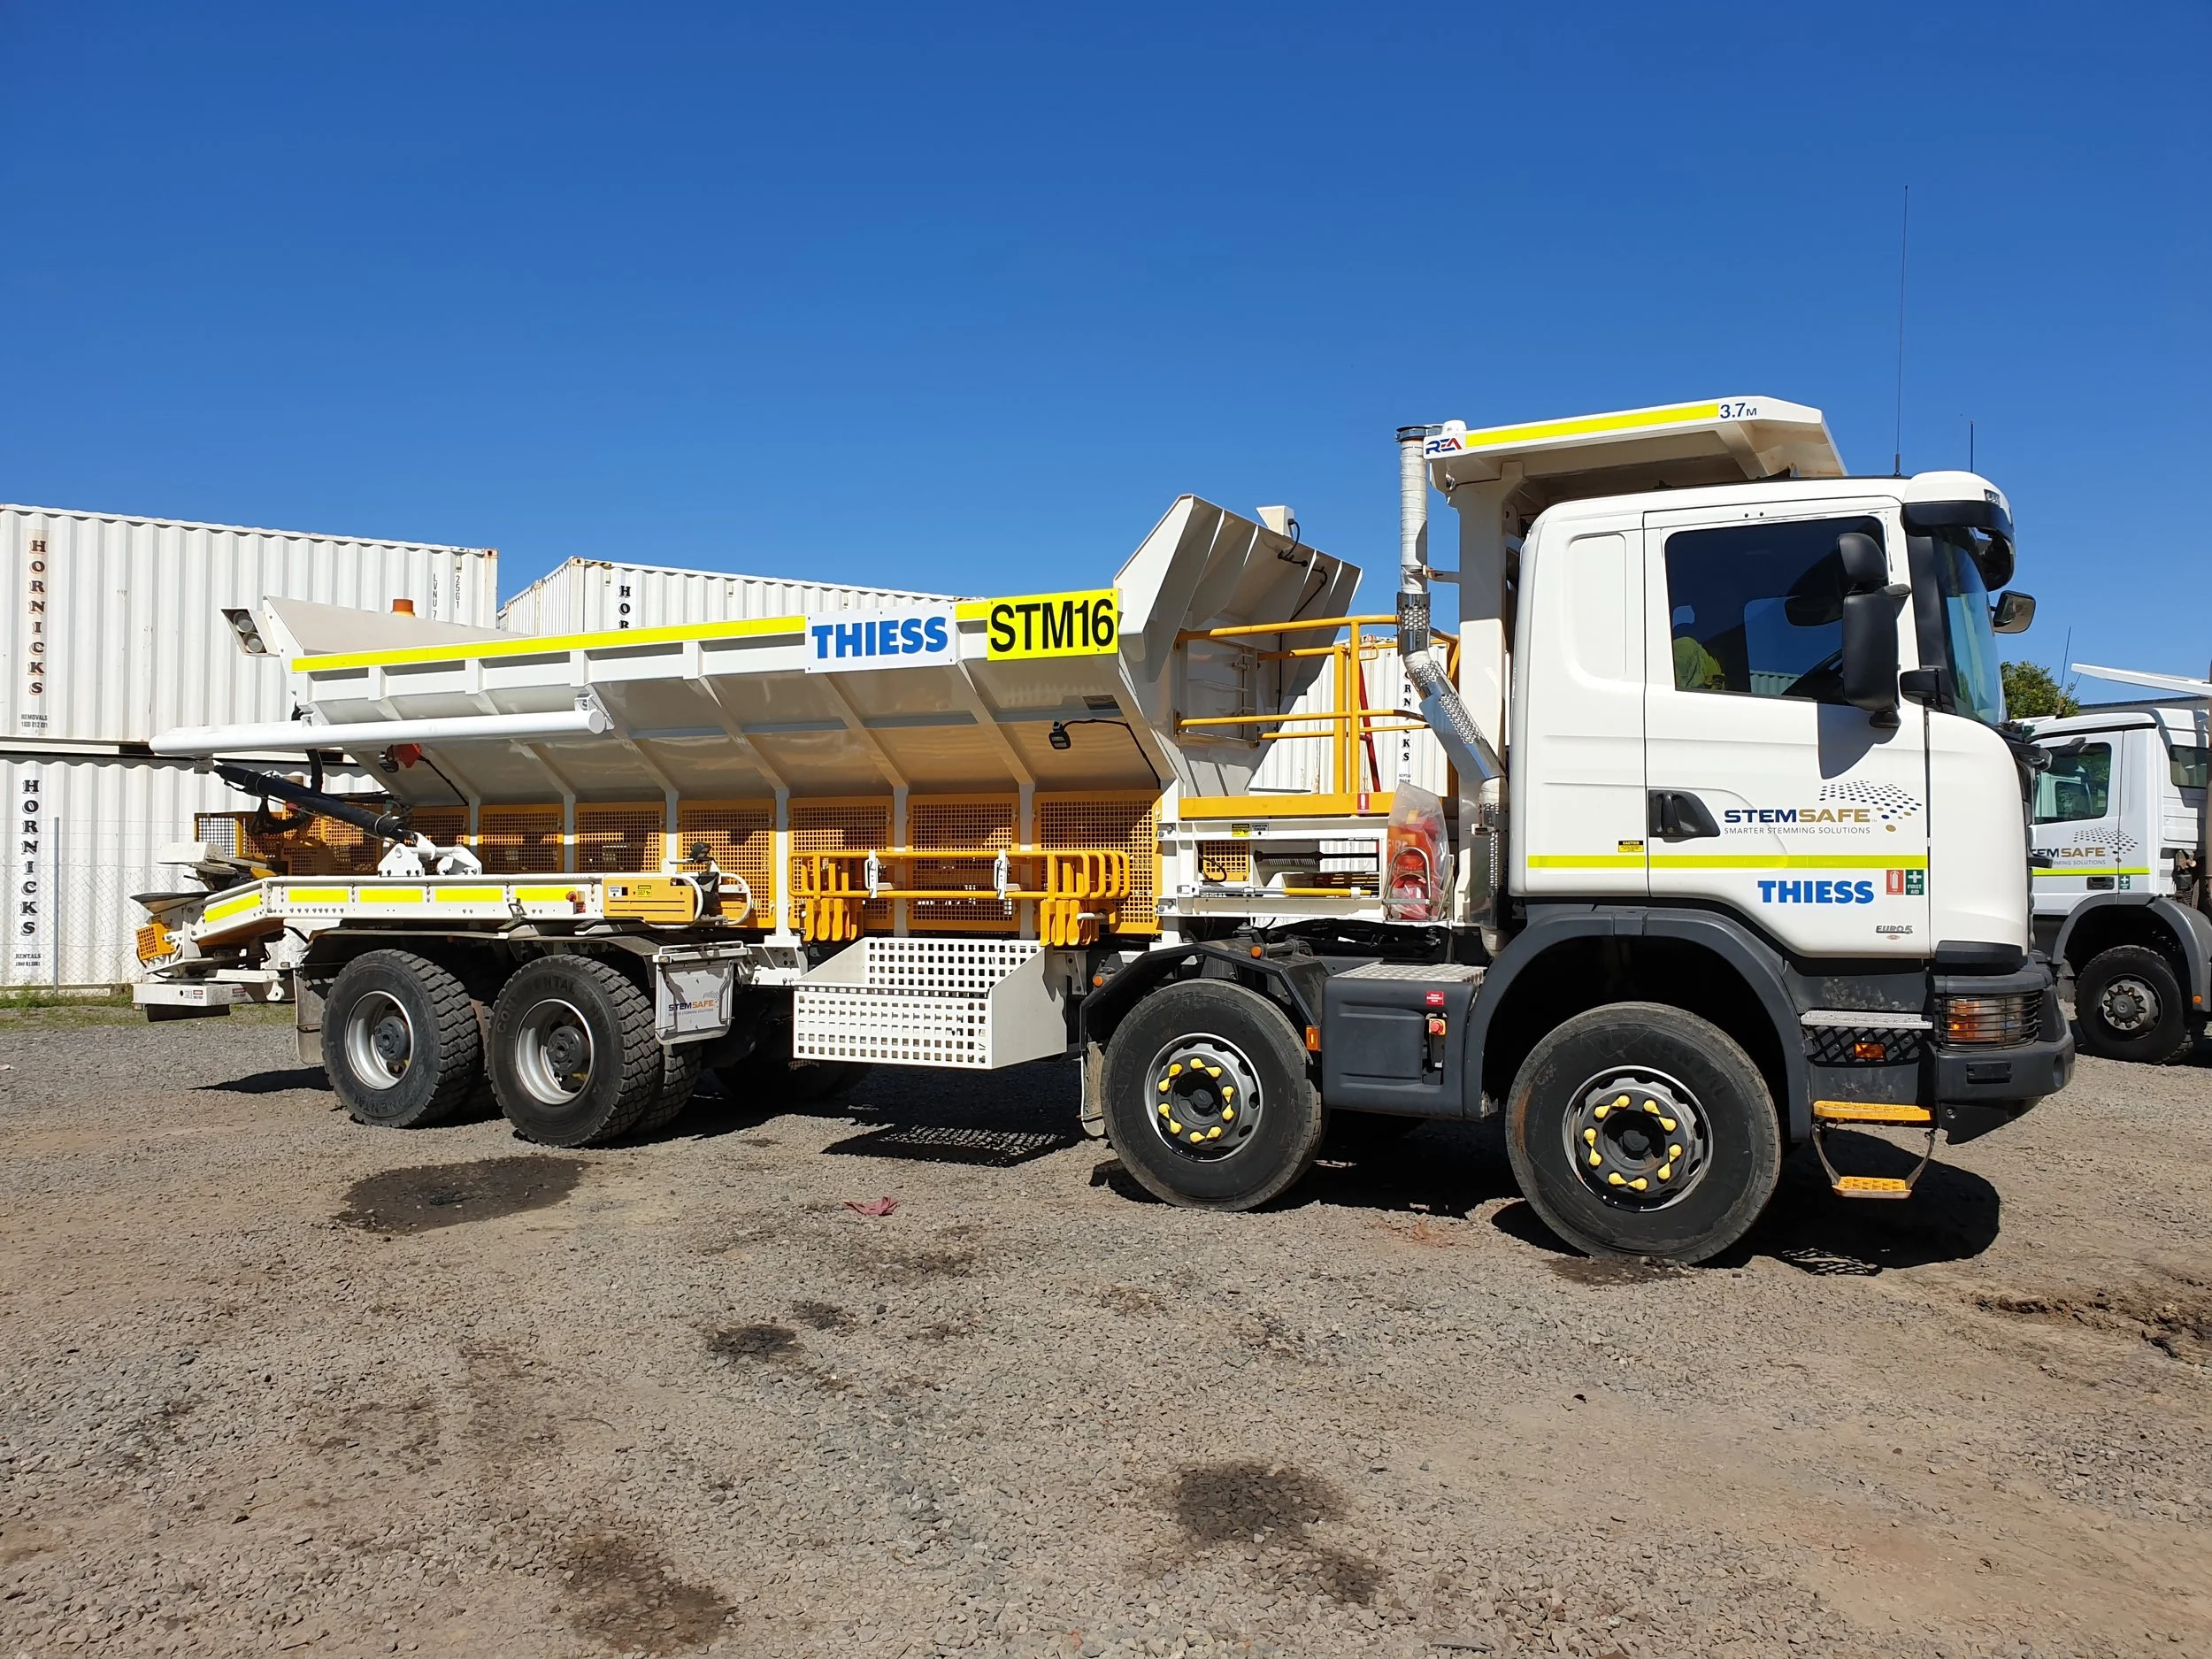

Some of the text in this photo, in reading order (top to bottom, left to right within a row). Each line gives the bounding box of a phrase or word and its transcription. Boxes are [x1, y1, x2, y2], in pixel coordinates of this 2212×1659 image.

[1425, 437, 1462, 455] REA
[29, 540, 46, 695] HORNICKS
[990, 598, 1115, 653] STM16
[811, 617, 949, 660] THIESS
[1724, 809, 1870, 823] STEMSAFE
[21, 780, 40, 935] HORNICKS
[2032, 847, 2106, 857] EMSAFE
[1757, 880, 1875, 904] THIESS
[668, 999, 715, 1011] STEMSAFE
